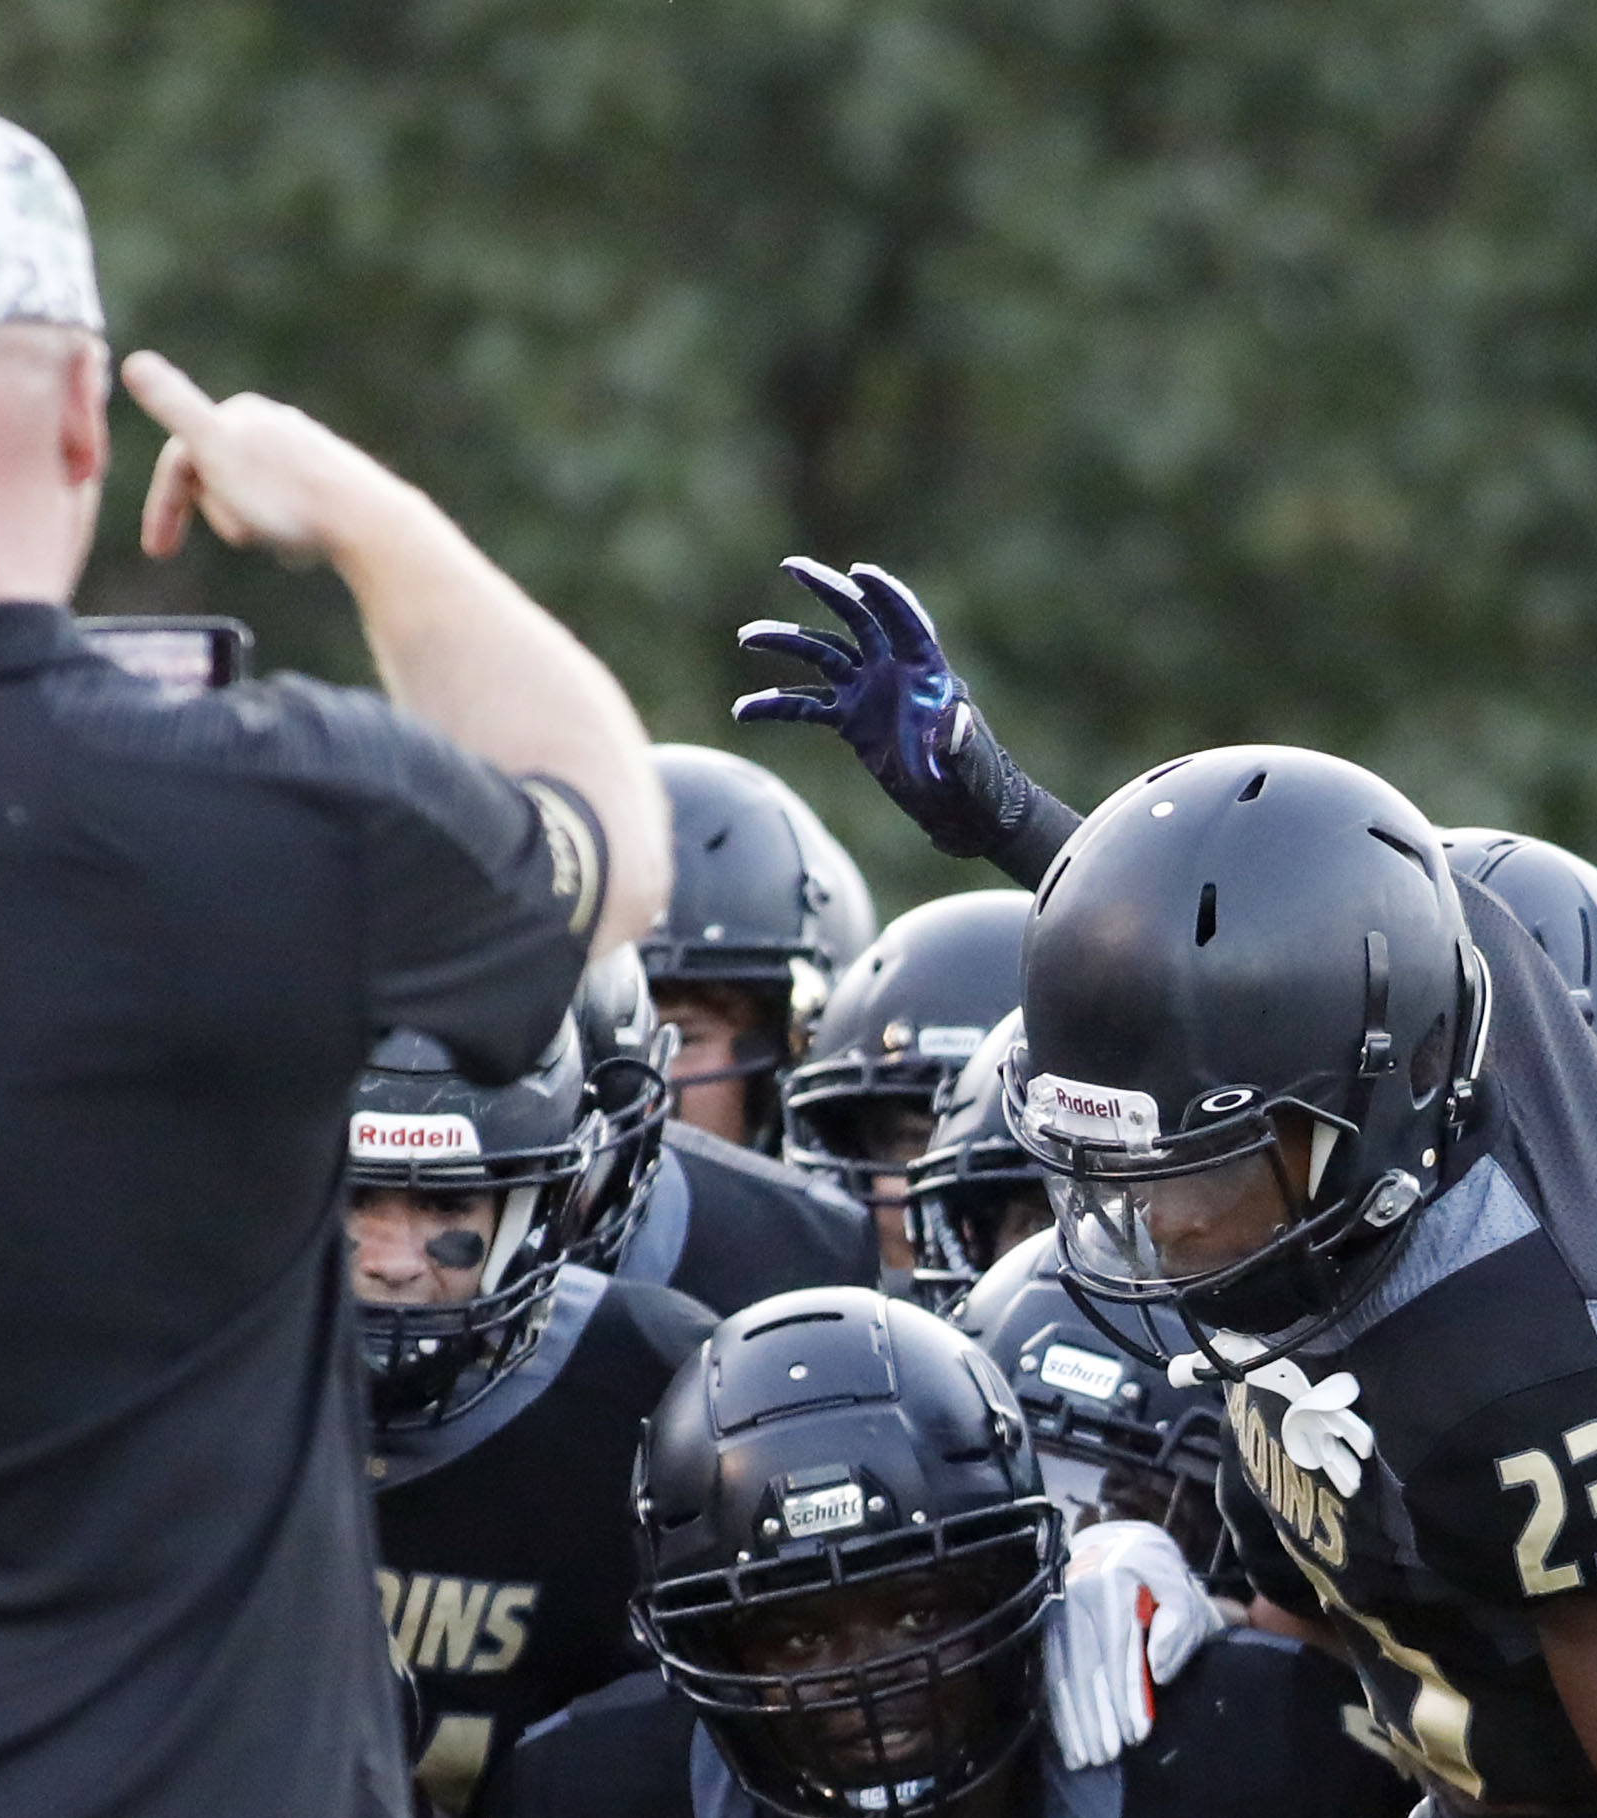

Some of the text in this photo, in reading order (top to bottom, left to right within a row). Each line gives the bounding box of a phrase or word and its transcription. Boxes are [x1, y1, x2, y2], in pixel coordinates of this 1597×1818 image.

[1055, 1087, 1122, 1119] Riddell
[358, 1124, 463, 1147] Riddell
[790, 1499, 859, 1528] schutt
